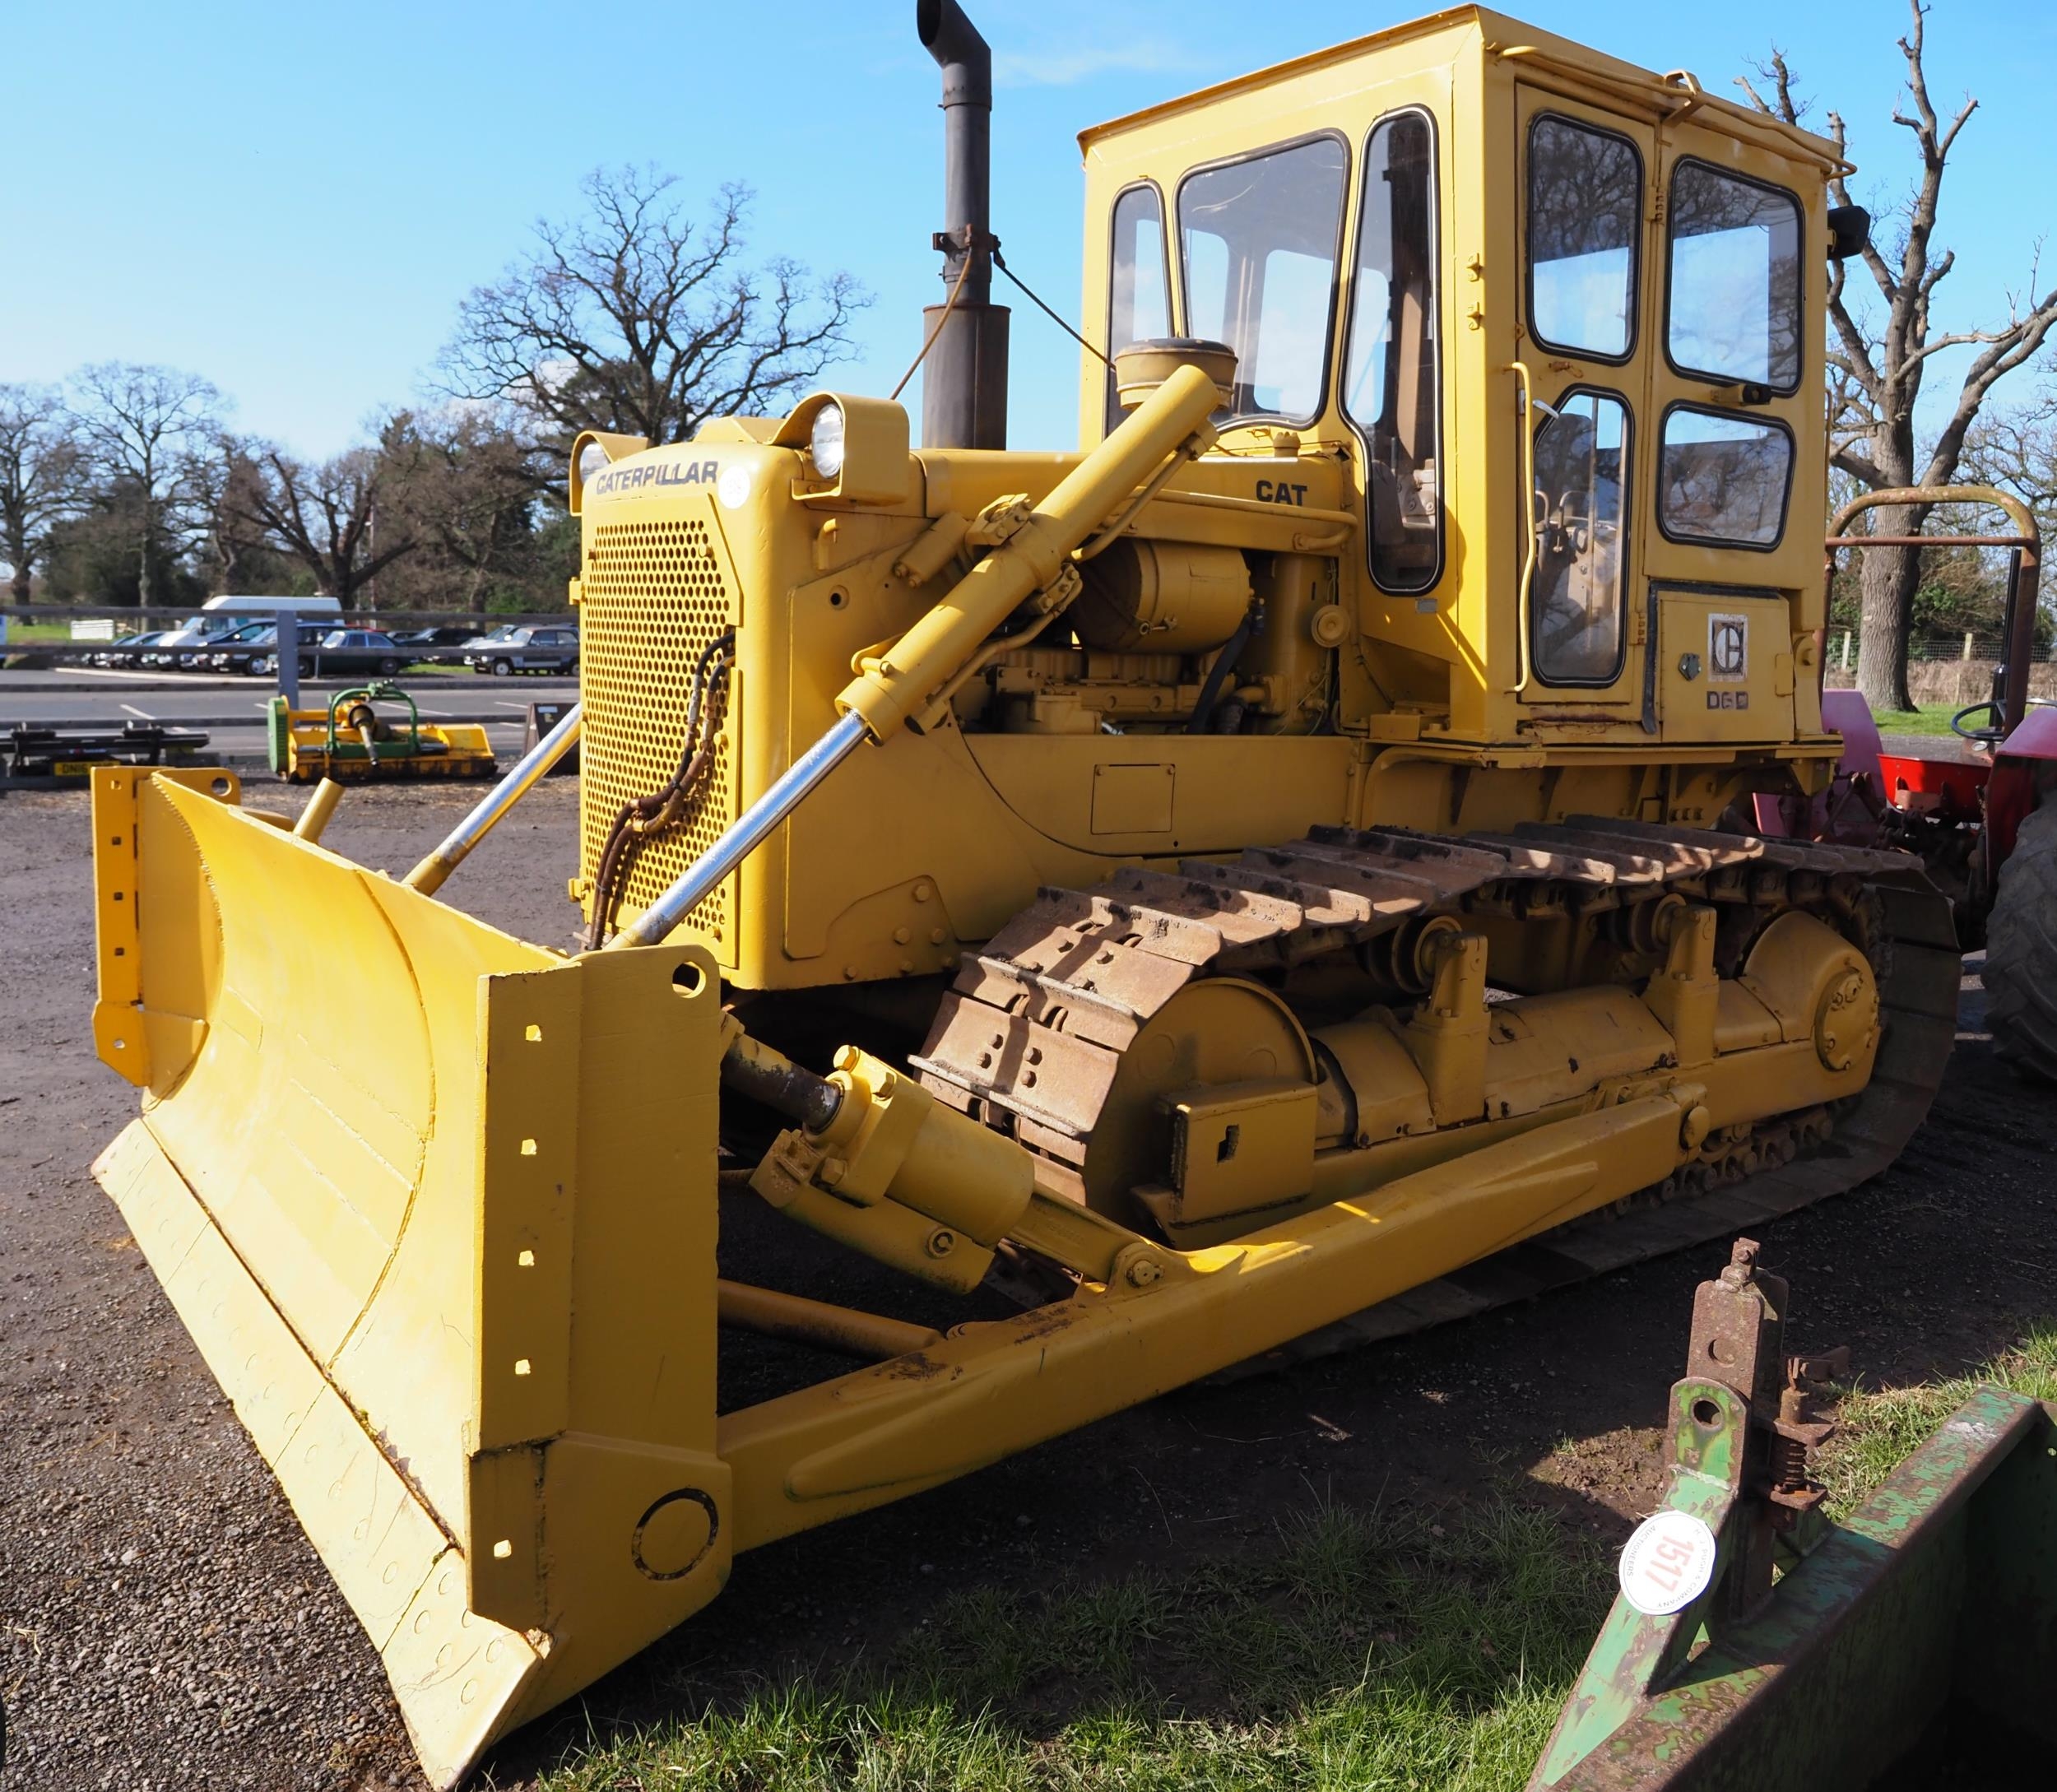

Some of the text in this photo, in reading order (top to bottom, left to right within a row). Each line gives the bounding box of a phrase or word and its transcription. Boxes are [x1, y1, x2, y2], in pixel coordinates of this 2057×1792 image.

[597, 461, 718, 494] CATERPILLAR
[1256, 480, 1308, 506] CAT
[1627, 1525, 1657, 1577] AUCTIONEERS
[1645, 1535, 1695, 1592] 1517
